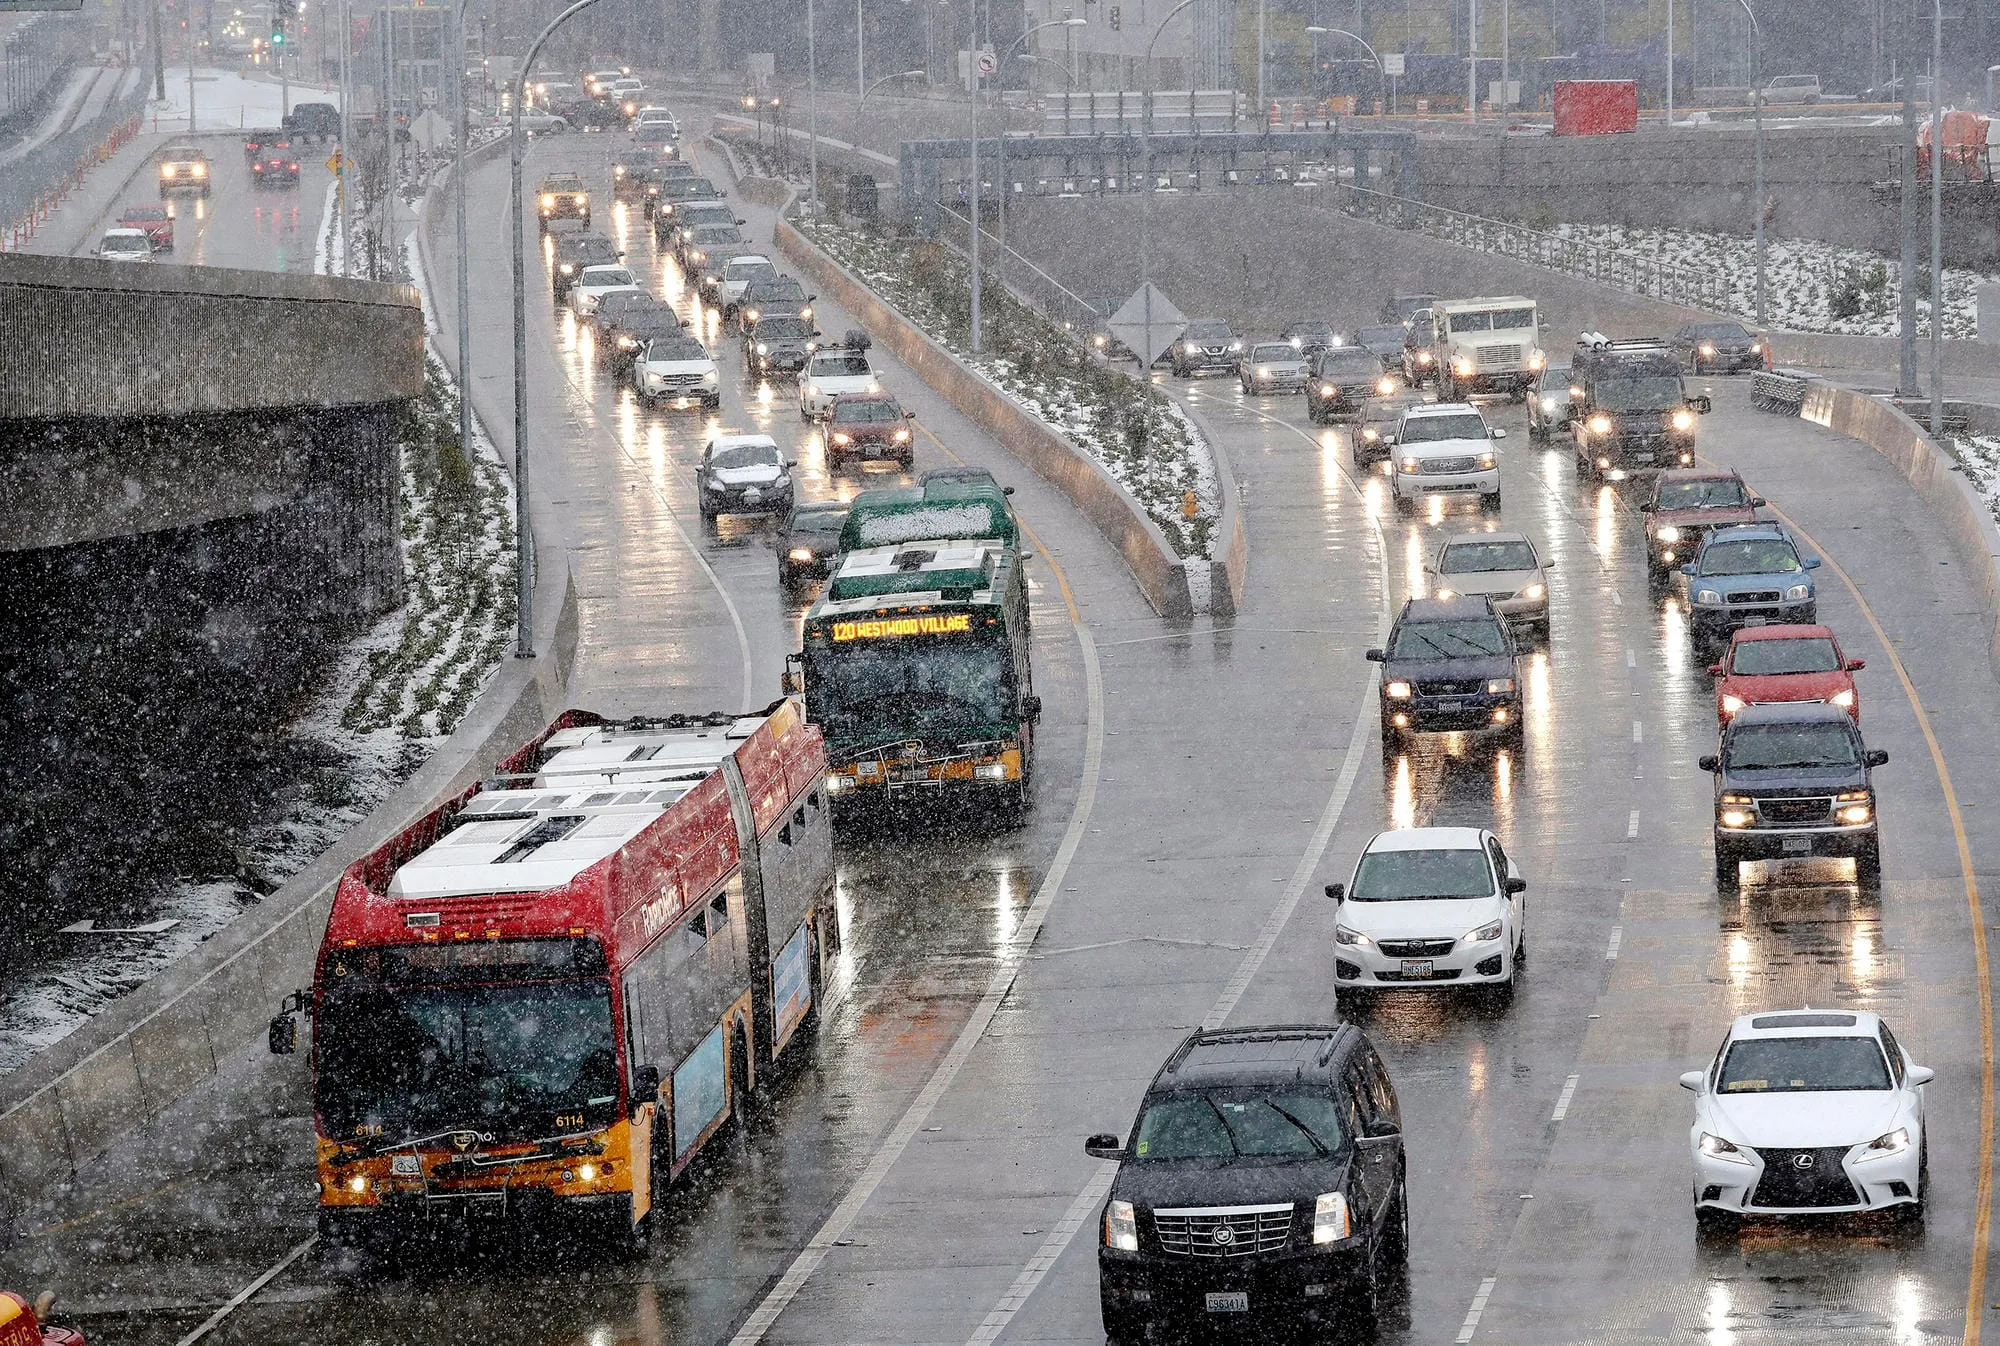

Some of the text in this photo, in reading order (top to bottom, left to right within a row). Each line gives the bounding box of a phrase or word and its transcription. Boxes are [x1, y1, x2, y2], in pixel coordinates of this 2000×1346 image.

[833, 614, 970, 641] 120 WESTWOOD VILLAGE
[556, 1113, 584, 1128] 6114
[356, 1124, 383, 1136] 6114
